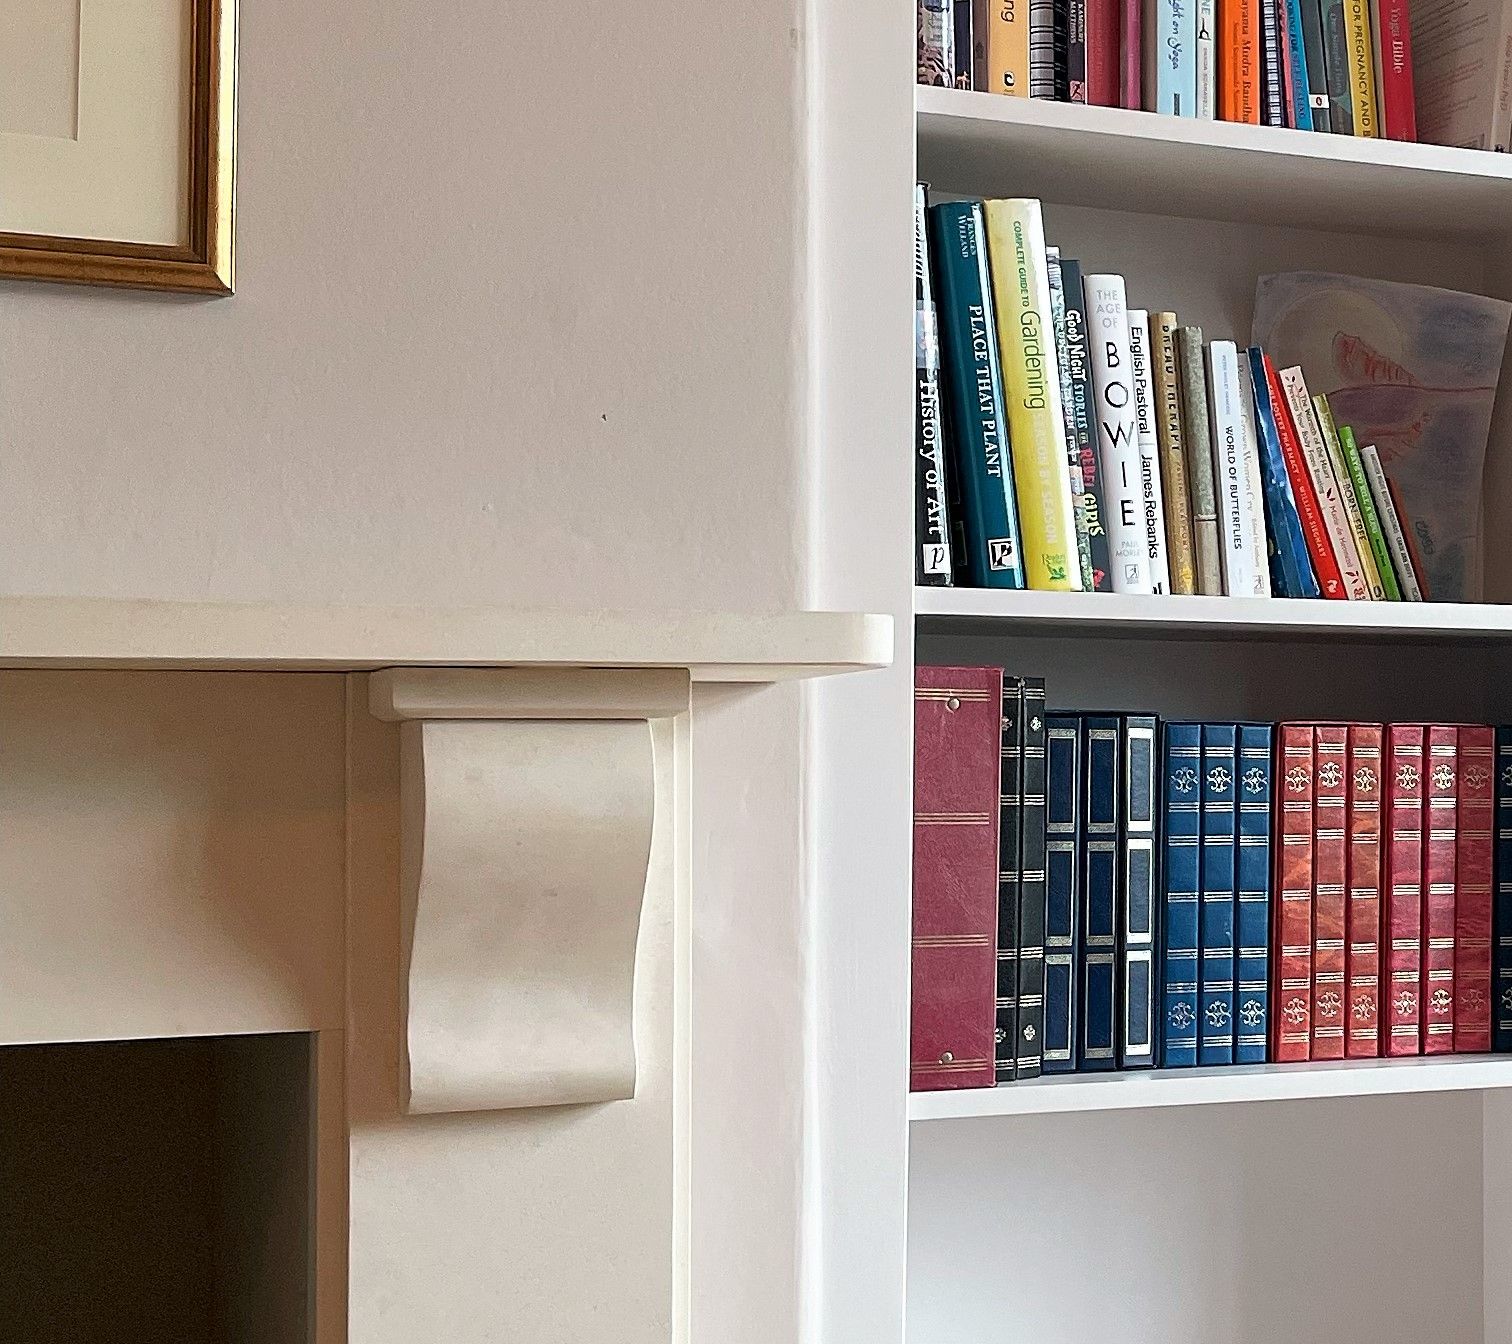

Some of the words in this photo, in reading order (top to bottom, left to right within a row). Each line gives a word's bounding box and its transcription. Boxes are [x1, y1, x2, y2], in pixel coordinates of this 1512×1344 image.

[1172, 20, 1180, 34] on
[1352, 0, 1362, 22] FOR
[1389, 7, 1401, 37] Yoga
[1167, 37, 1183, 70] Yoga
[1240, 39, 1252, 77] Mudra
[1289, 34, 1300, 52] FOR
[1392, 40, 1404, 74] Bible
[1353, 25, 1368, 96] PREGNANCY
[1360, 100, 1369, 128] AND
[1013, 220, 1027, 265] COMPLETE
[1018, 267, 1029, 293] GUIDE
[1096, 290, 1118, 301] THE
[1021, 296, 1030, 307] TO
[1096, 302, 1121, 314] AGE
[969, 305, 988, 361] PLACE
[1102, 316, 1118, 328] OF
[1019, 310, 1048, 409] Gardening
[1130, 326, 1145, 377] English
[975, 368, 992, 414] THAT
[1074, 384, 1087, 429] STORIES
[1134, 379, 1149, 434] Pastoral
[1287, 384, 1301, 411] Prevents
[1300, 394, 1309, 407] The
[919, 379, 939, 465] History
[1102, 341, 1135, 527] BOWIE
[1295, 413, 1305, 429] Your
[1304, 408, 1319, 436] Warmth
[982, 419, 1001, 478] PLANT
[1033, 411, 1049, 467] SEASON
[1225, 426, 1236, 464] WORLD
[1279, 432, 1299, 474] PHARMACY
[1300, 430, 1312, 448] Body
[1316, 447, 1326, 458] the
[1080, 448, 1097, 488] REBEL
[1228, 467, 1238, 482] OF
[1307, 450, 1317, 468] From
[1319, 459, 1331, 480] Heart
[1348, 449, 1359, 472] WAYS
[925, 470, 940, 491] of
[1037, 470, 1051, 488] BY
[1142, 454, 1154, 499] James
[1311, 469, 1326, 495] Rusting
[927, 499, 946, 535] Art
[1040, 490, 1058, 544] SEASON
[1083, 492, 1103, 537] GIRLS
[1229, 484, 1242, 550] BUTTERFLIES
[1298, 486, 1314, 519] WILLIAM
[1328, 505, 1339, 526] Marie
[1342, 483, 1358, 512] BORN
[1352, 517, 1368, 542] FREE
[1120, 540, 1140, 550] PAUL
[1145, 500, 1159, 559] Rebanks
